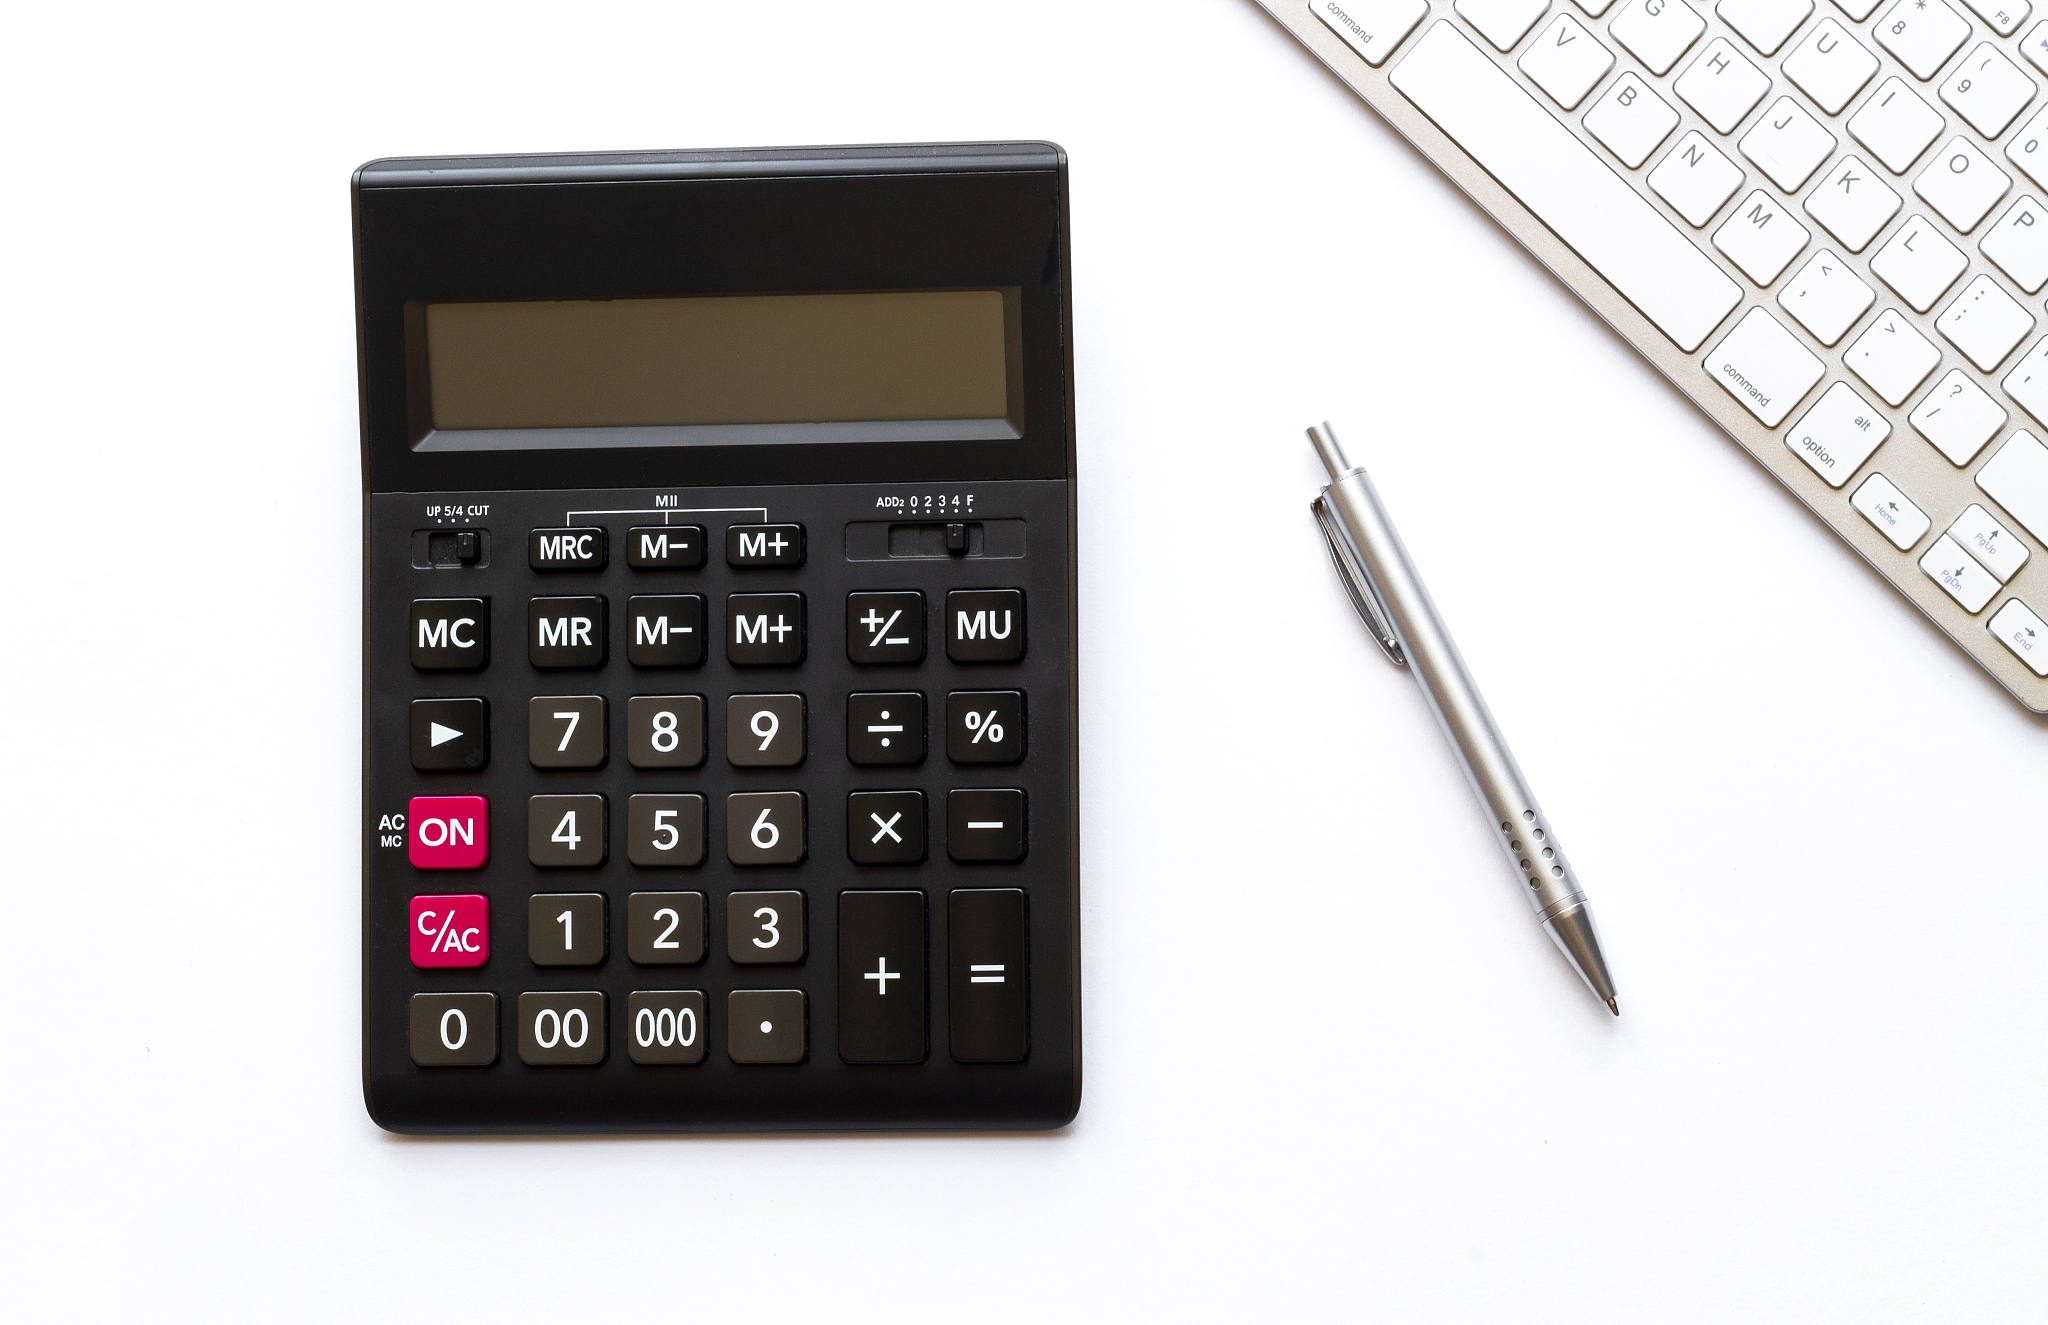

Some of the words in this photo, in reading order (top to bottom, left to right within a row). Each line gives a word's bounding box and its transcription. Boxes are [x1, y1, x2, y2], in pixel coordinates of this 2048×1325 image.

[1644, 0, 1666, 17] G
[1994, 10, 2011, 26] F8
[1327, 2, 1374, 44] command
[1891, 20, 1907, 35] 8
[1555, 27, 1577, 48] V
[1816, 31, 1839, 54] U
[1706, 51, 1731, 76] H
[1616, 85, 1638, 107] B
[1957, 78, 1972, 94] 9
[1773, 115, 1794, 130] J
[1681, 144, 1705, 168] N
[1949, 153, 1970, 174] O
[1836, 169, 1861, 195] K
[1746, 203, 1774, 230] M
[2012, 210, 2036, 228] P
[1903, 230, 1919, 253] L
[1723, 363, 1772, 408] command
[1949, 384, 1963, 398] ?
[1853, 415, 1872, 432] alt
[1802, 435, 1836, 469] option
[427, 506, 441, 516] UP
[445, 506, 463, 516] 5/4
[468, 505, 489, 515] CUT
[910, 496, 918, 507] 0
[925, 496, 931, 506] 2
[939, 495, 945, 506] 3
[952, 495, 960, 506] 4
[967, 495, 973, 506] F
[1873, 502, 1897, 526] Home
[541, 535, 592, 559] MRC
[740, 533, 788, 557] M+
[1973, 532, 1997, 556] PgUp
[1940, 569, 1963, 592] PgDn
[419, 618, 475, 648] MC
[539, 617, 592, 646] MR
[736, 615, 792, 643] M+
[958, 610, 1011, 639] MU
[2012, 631, 2033, 652] End
[554, 712, 579, 751] 7
[652, 711, 678, 752] 8
[751, 711, 778, 750] 9
[868, 711, 903, 747] ÷
[965, 711, 1003, 743] %
[379, 814, 405, 830] AC
[419, 818, 473, 846] ON
[552, 811, 580, 850] 4
[652, 810, 678, 850] 5
[751, 809, 779, 848] 6
[381, 835, 402, 847] MC
[418, 910, 480, 952] C/AC
[557, 911, 572, 950] 1
[654, 908, 679, 948] 2
[753, 907, 779, 948] 3
[864, 957, 900, 994] +
[970, 964, 1005, 984] =
[441, 1009, 467, 1049] 0
[535, 1009, 588, 1048] 00
[636, 1008, 696, 1047] 000
